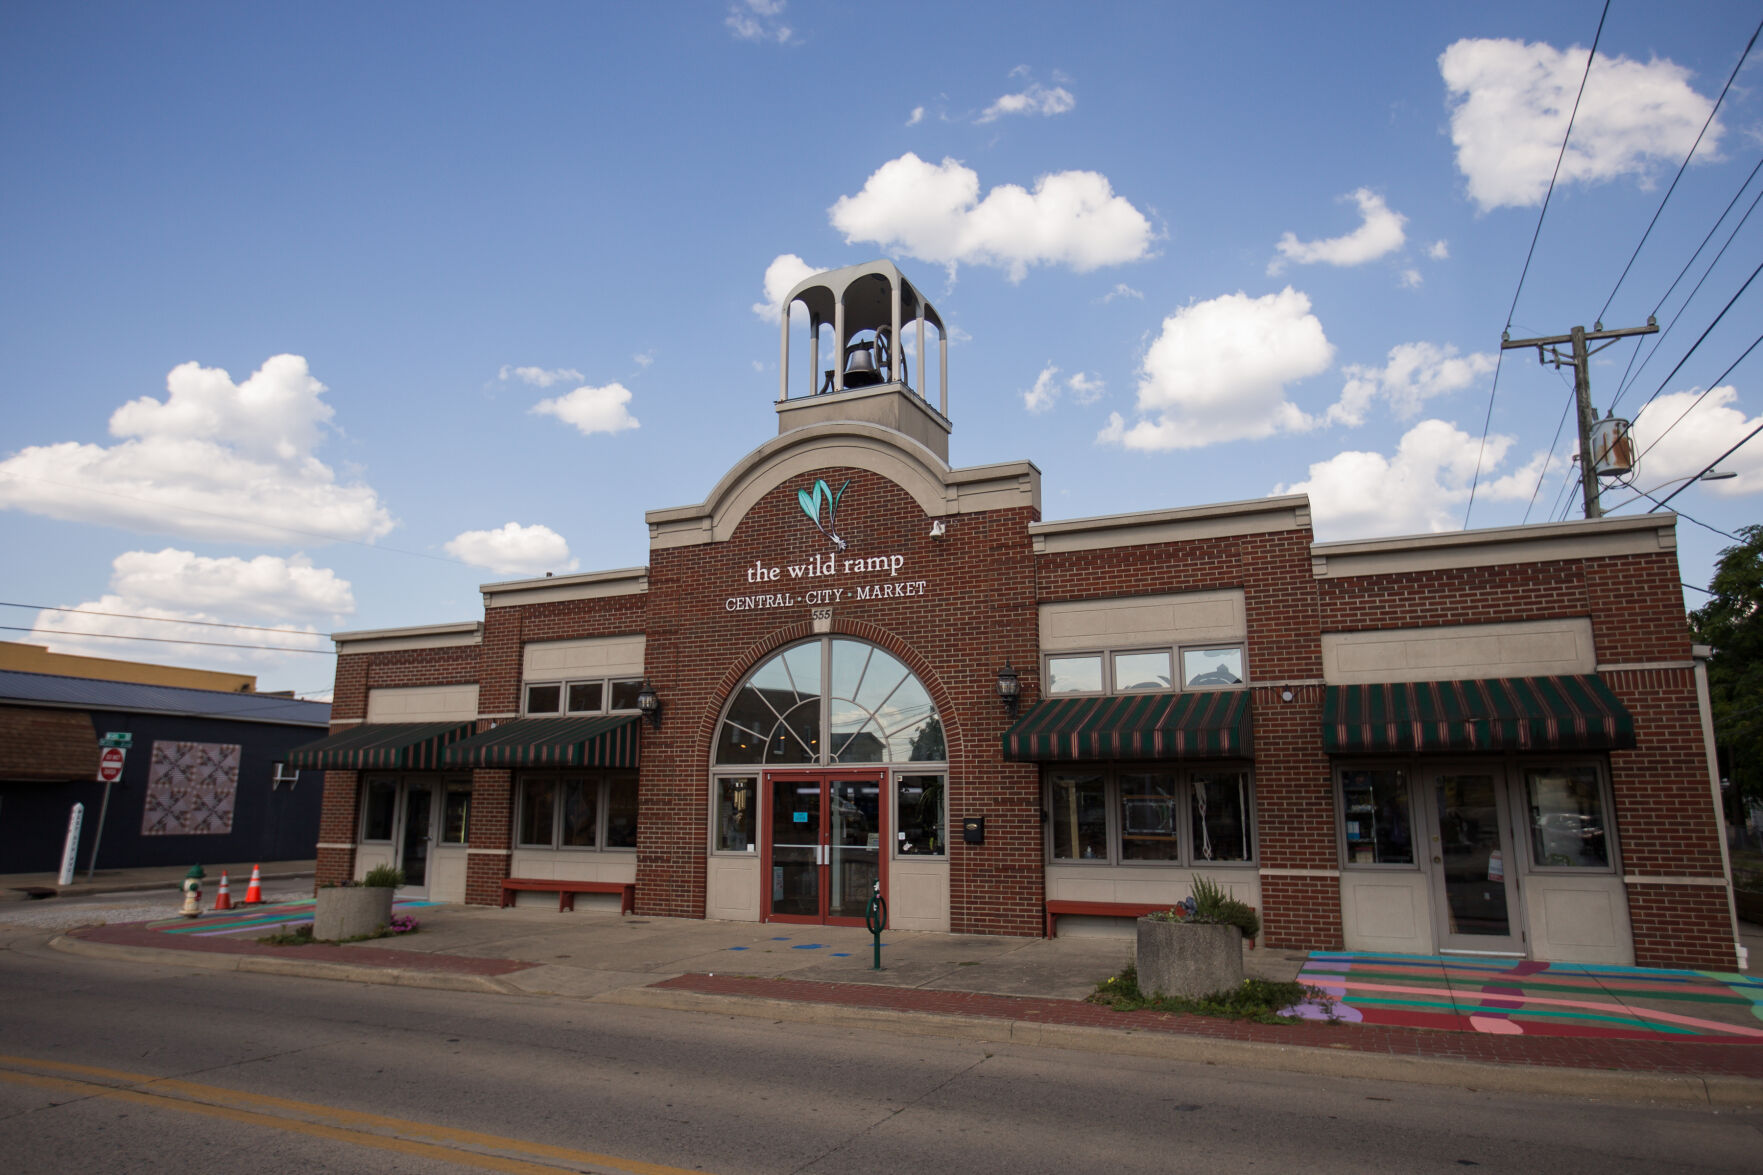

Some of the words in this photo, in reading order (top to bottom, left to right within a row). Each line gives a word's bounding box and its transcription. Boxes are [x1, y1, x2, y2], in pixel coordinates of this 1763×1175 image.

[747, 560, 781, 583] the
[787, 552, 836, 578] wild
[843, 554, 904, 577] ramp
[725, 593, 794, 611] CENTRAL
[805, 588, 844, 605] CITY
[856, 581, 927, 600] MARKET
[812, 609, 831, 620] 555
